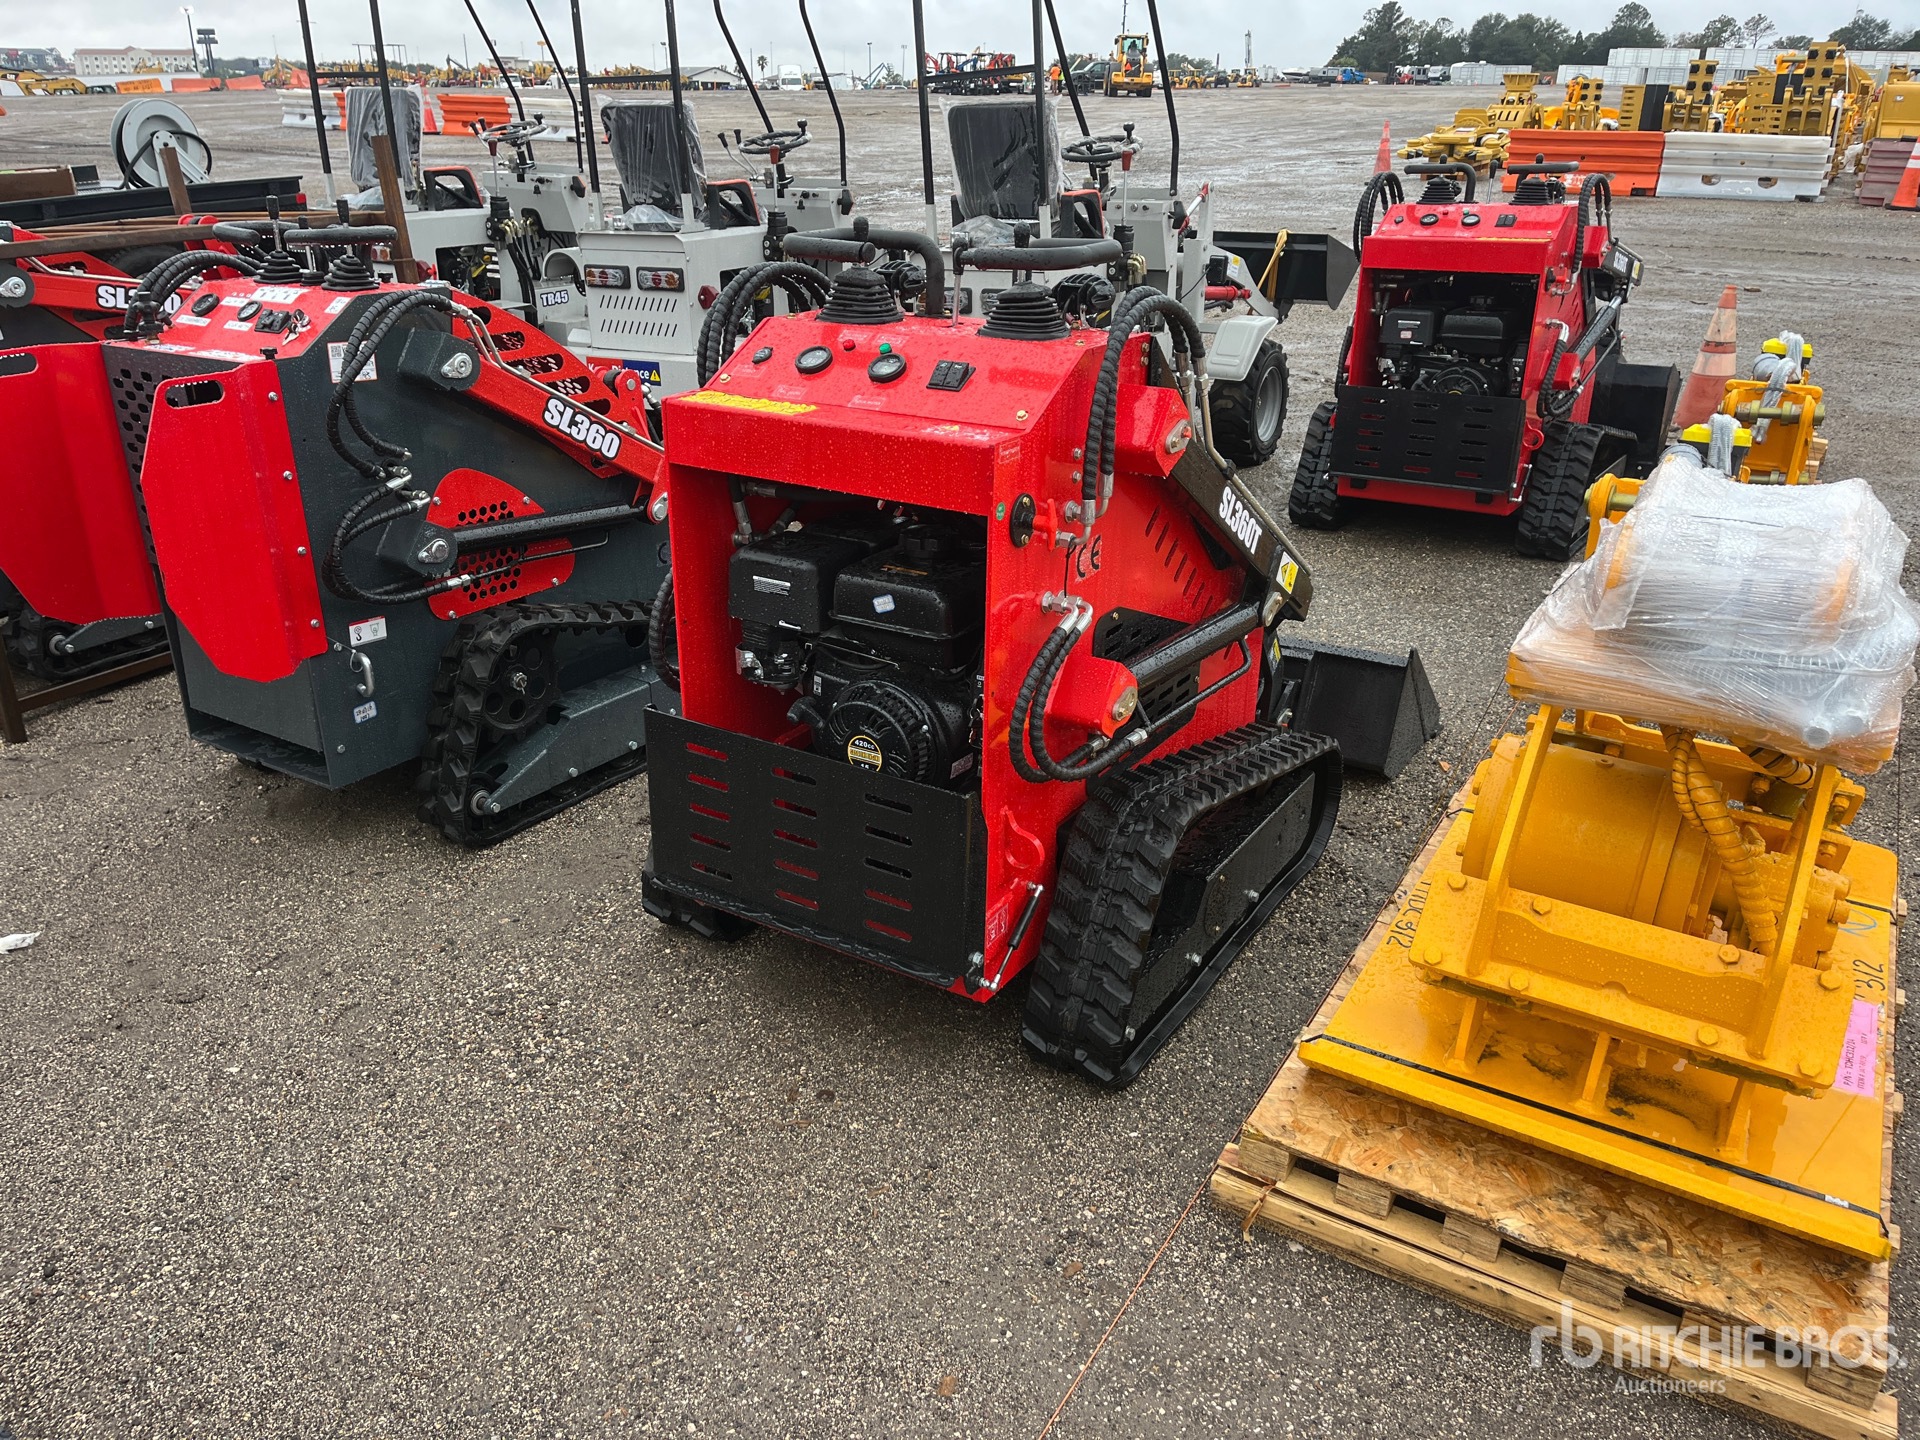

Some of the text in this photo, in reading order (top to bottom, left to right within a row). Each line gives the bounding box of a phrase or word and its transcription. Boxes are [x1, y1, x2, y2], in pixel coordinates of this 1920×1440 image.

[98, 284, 182, 314] SL0
[540, 290, 569, 307] TR45
[543, 397, 621, 459] SL360
[1219, 486, 1263, 555] SL360T
[854, 739, 876, 750] 420cc
[1852, 959, 1886, 991] 312
